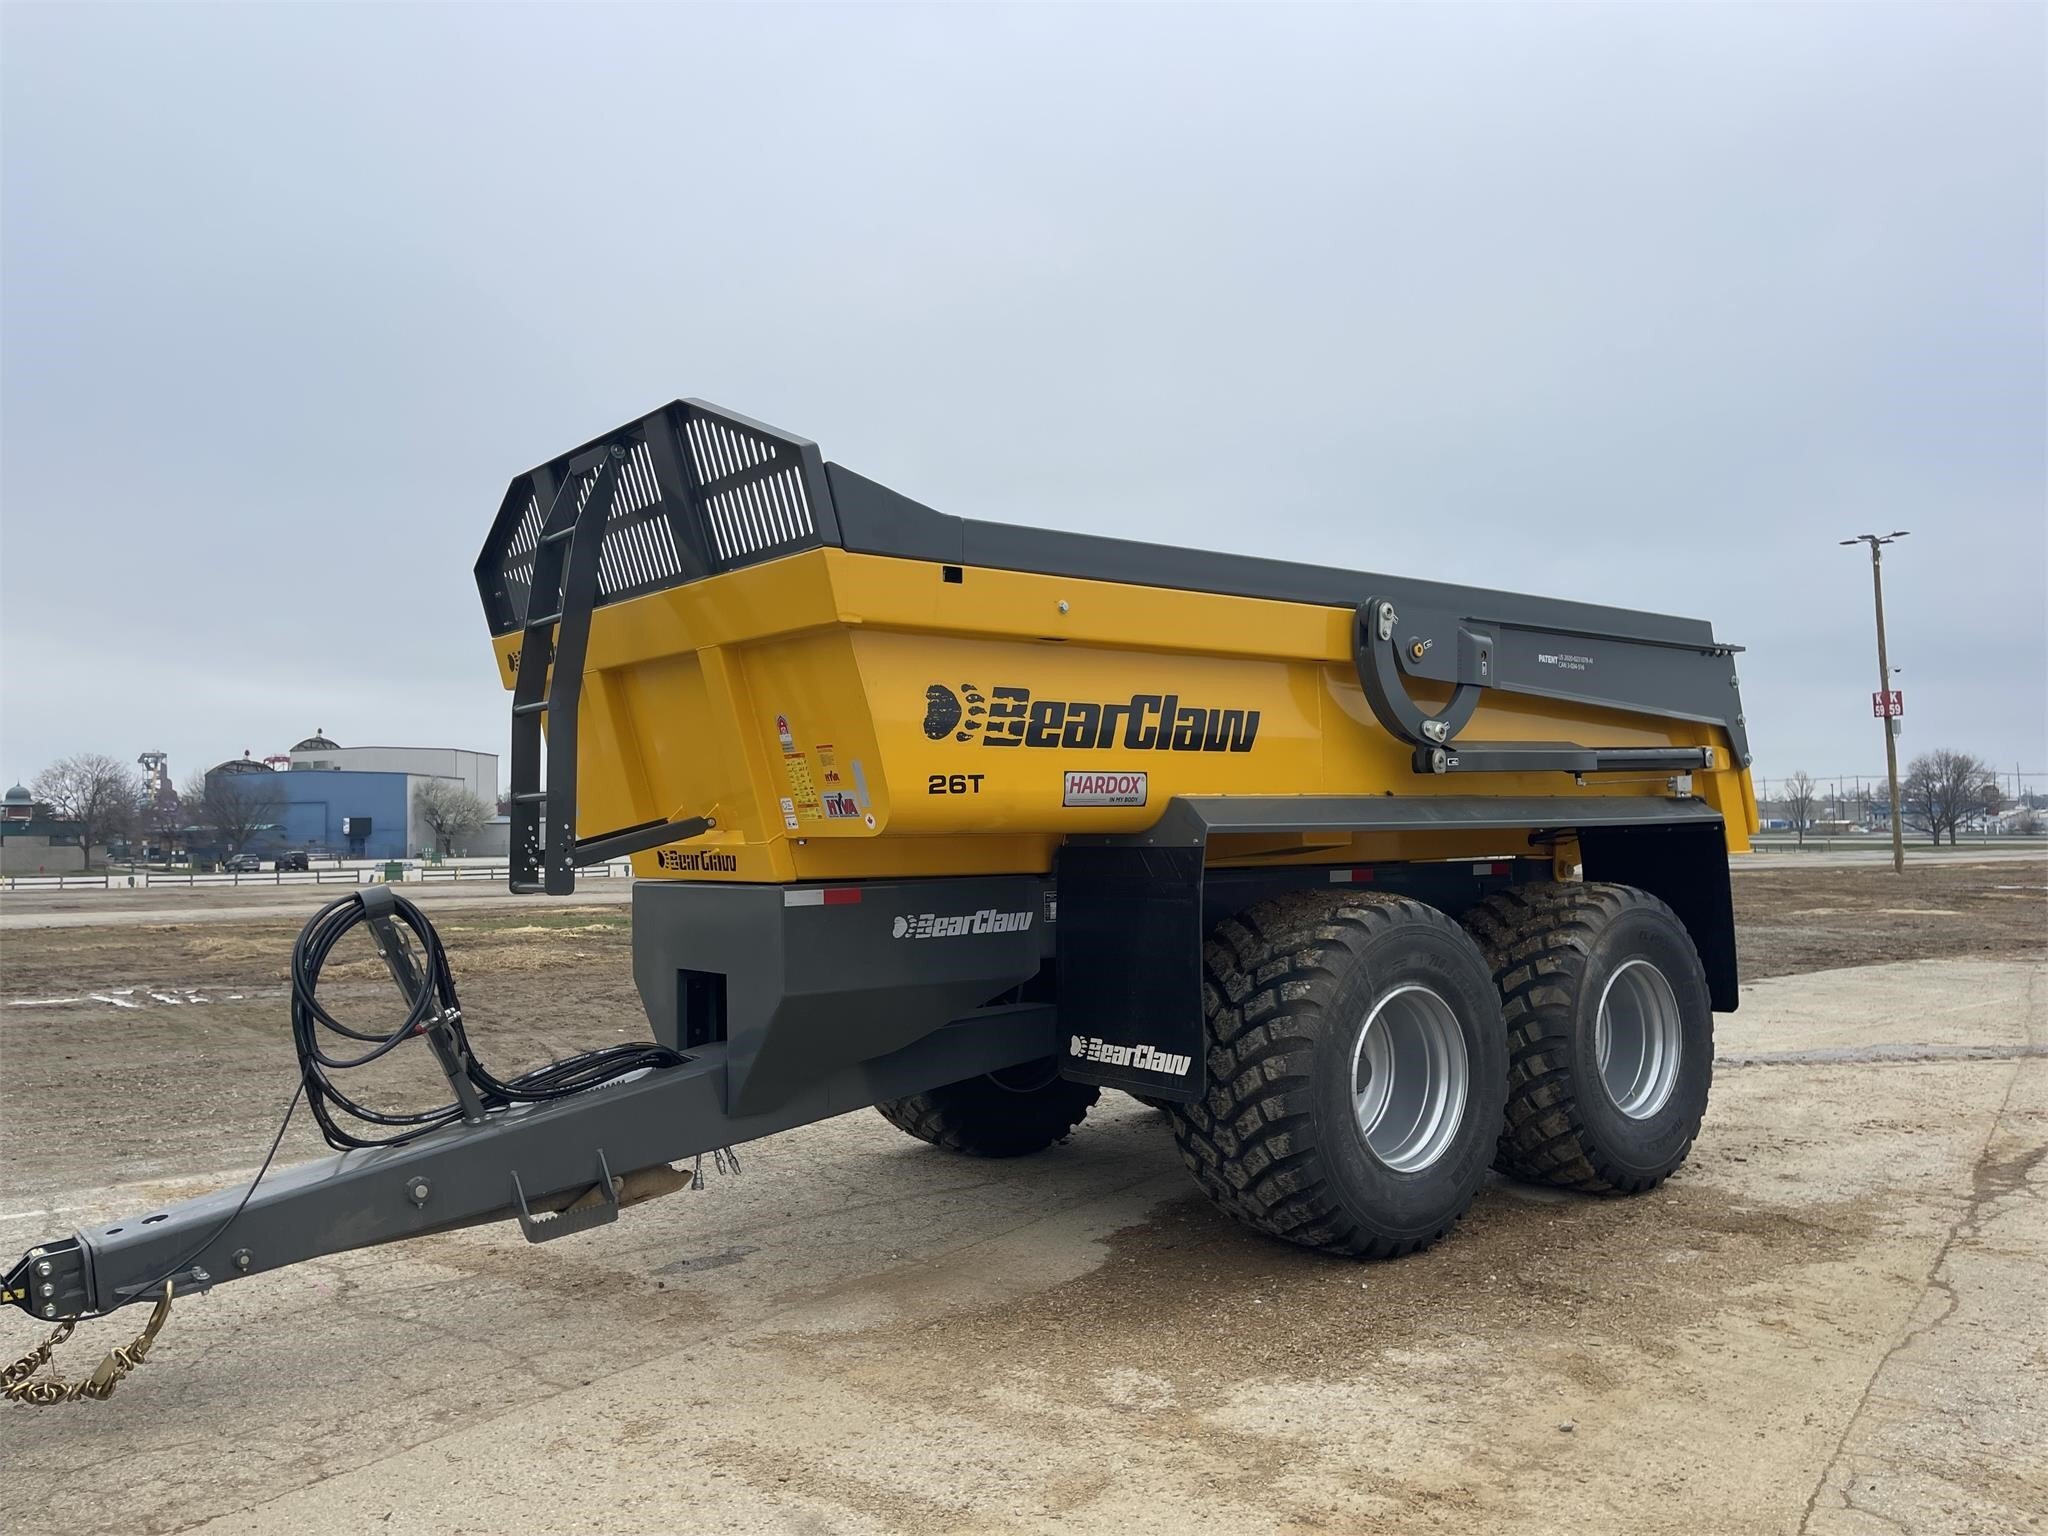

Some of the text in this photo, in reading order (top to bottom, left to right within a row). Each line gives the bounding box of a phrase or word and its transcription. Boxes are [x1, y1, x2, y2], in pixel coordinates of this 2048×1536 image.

[1538, 654, 1558, 664] PATENT
[1876, 693, 1882, 704] K
[1889, 692, 1898, 703] K
[1875, 705, 1884, 716] 59
[1889, 704, 1901, 715] 59
[983, 686, 1260, 752] BearClaw
[929, 774, 984, 794] 26T
[1069, 776, 1140, 794] HARDOX
[826, 793, 858, 815] HYVA
[915, 909, 1033, 939] BearClaw
[1087, 1037, 1191, 1076] BearClaw
